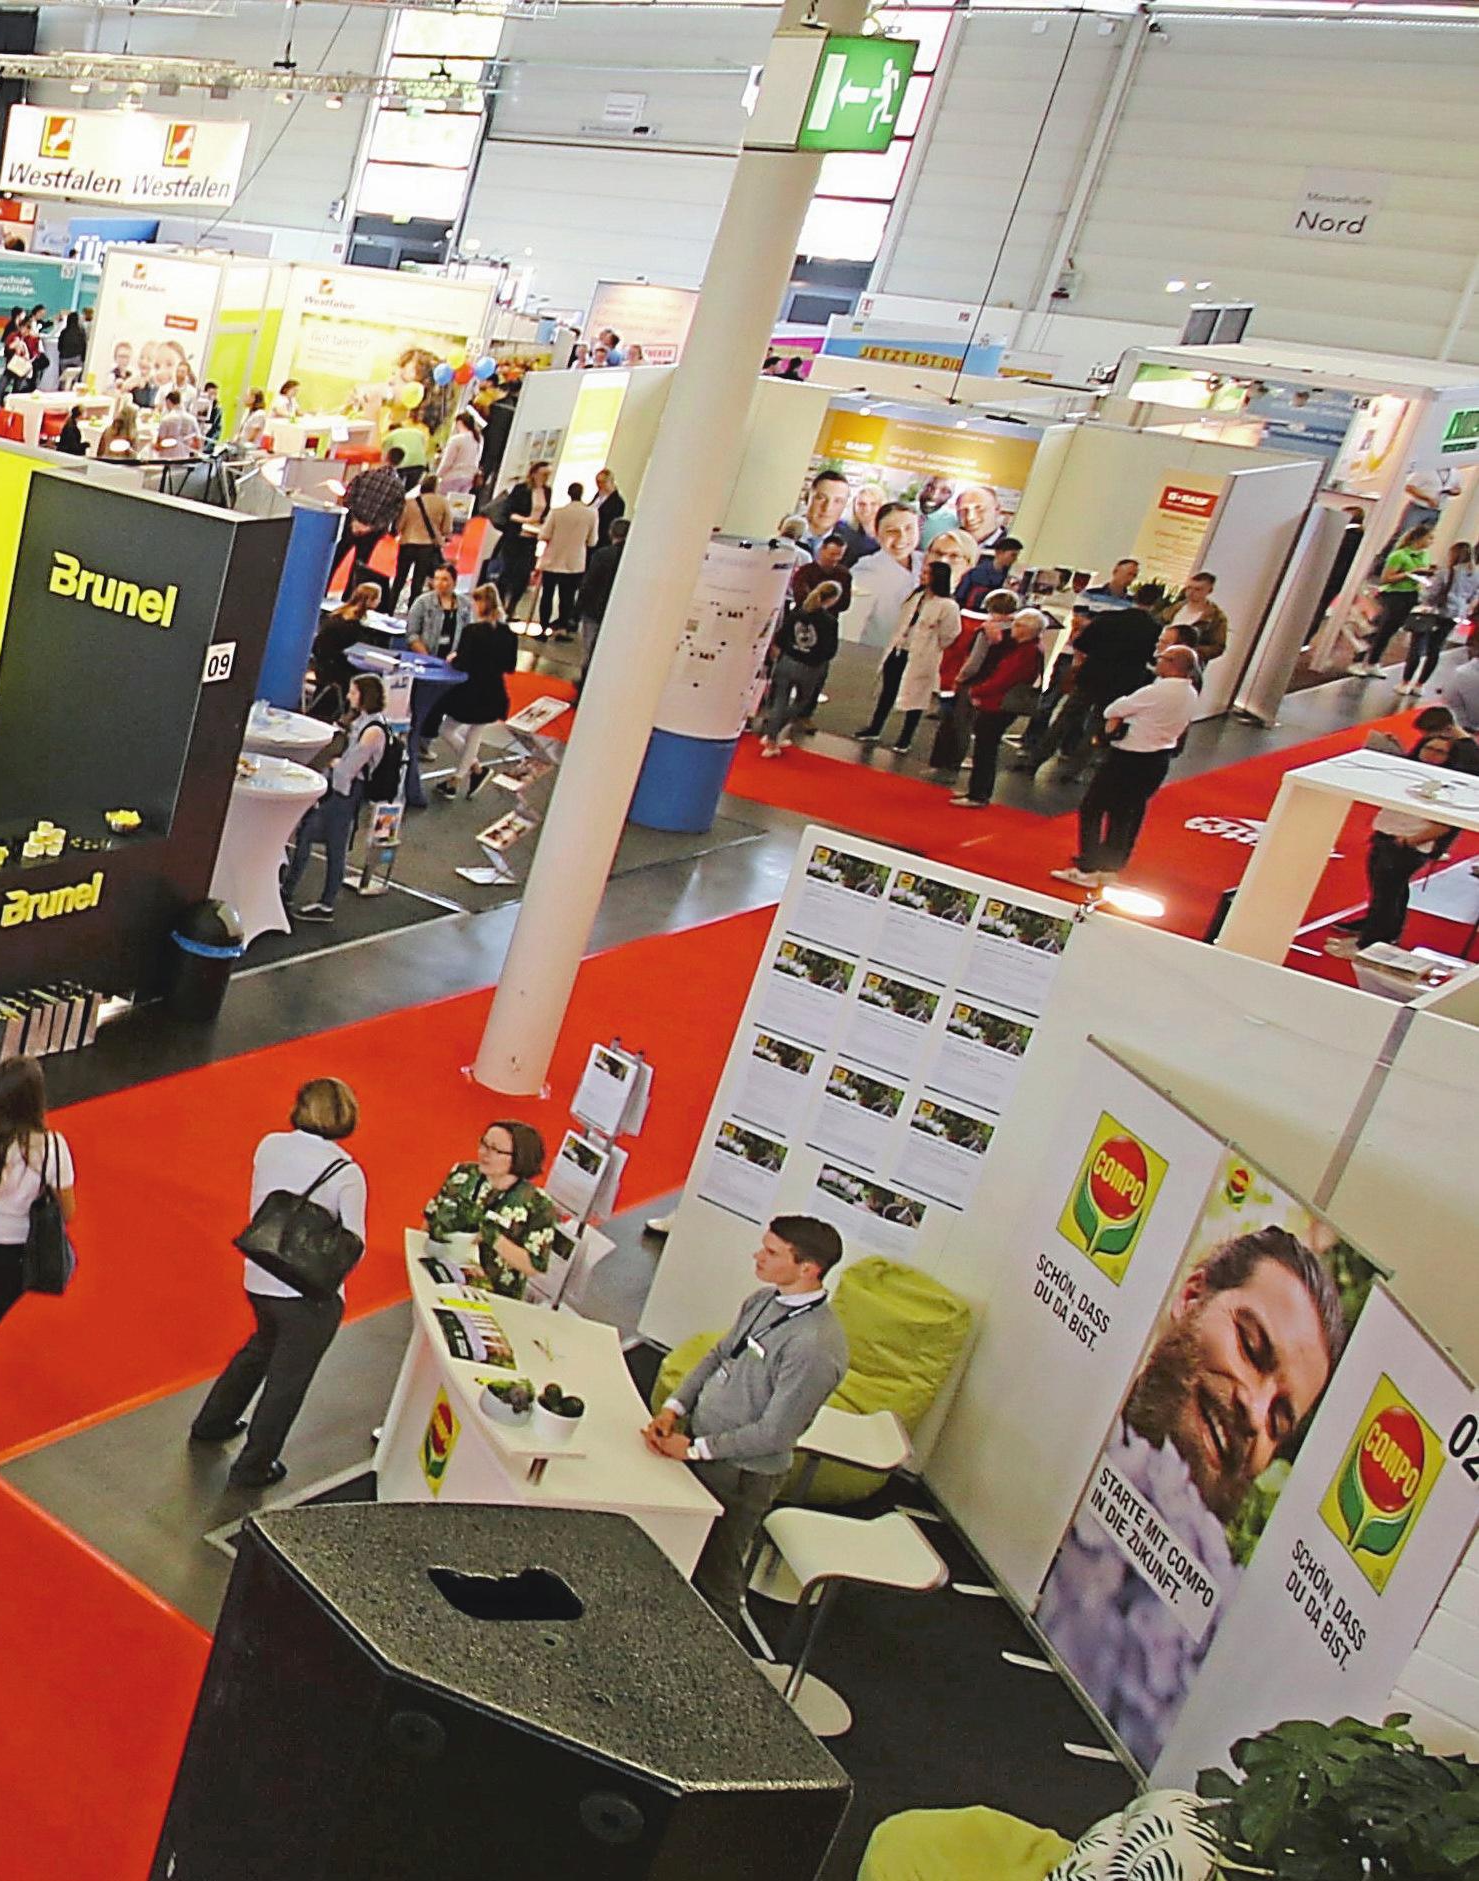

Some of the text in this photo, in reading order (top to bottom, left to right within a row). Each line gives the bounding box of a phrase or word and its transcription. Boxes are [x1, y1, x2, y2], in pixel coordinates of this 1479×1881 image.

[7, 162, 231, 200] Westfalen Westfalen
[1295, 210, 1368, 234] Nord
[858, 345, 910, 364] JETZT
[49, 551, 178, 628] Brunel
[207, 653, 230, 678] 09
[0, 871, 104, 928] Brunel
[1093, 1150, 1145, 1207] COMPO
[1033, 1279, 1098, 1353] DU DA BIST.
[1036, 1253, 1111, 1334] SCHÖN, DASS
[1364, 1421, 1419, 1499] COMPO
[1090, 1487, 1183, 1605] IN DIE ZUKUNFT.
[1099, 1467, 1215, 1608] STARTE MIT COMPO
[1285, 1570, 1352, 1673] DU DA BIST.
[1292, 1539, 1367, 1652] SCHÖN, DASS
